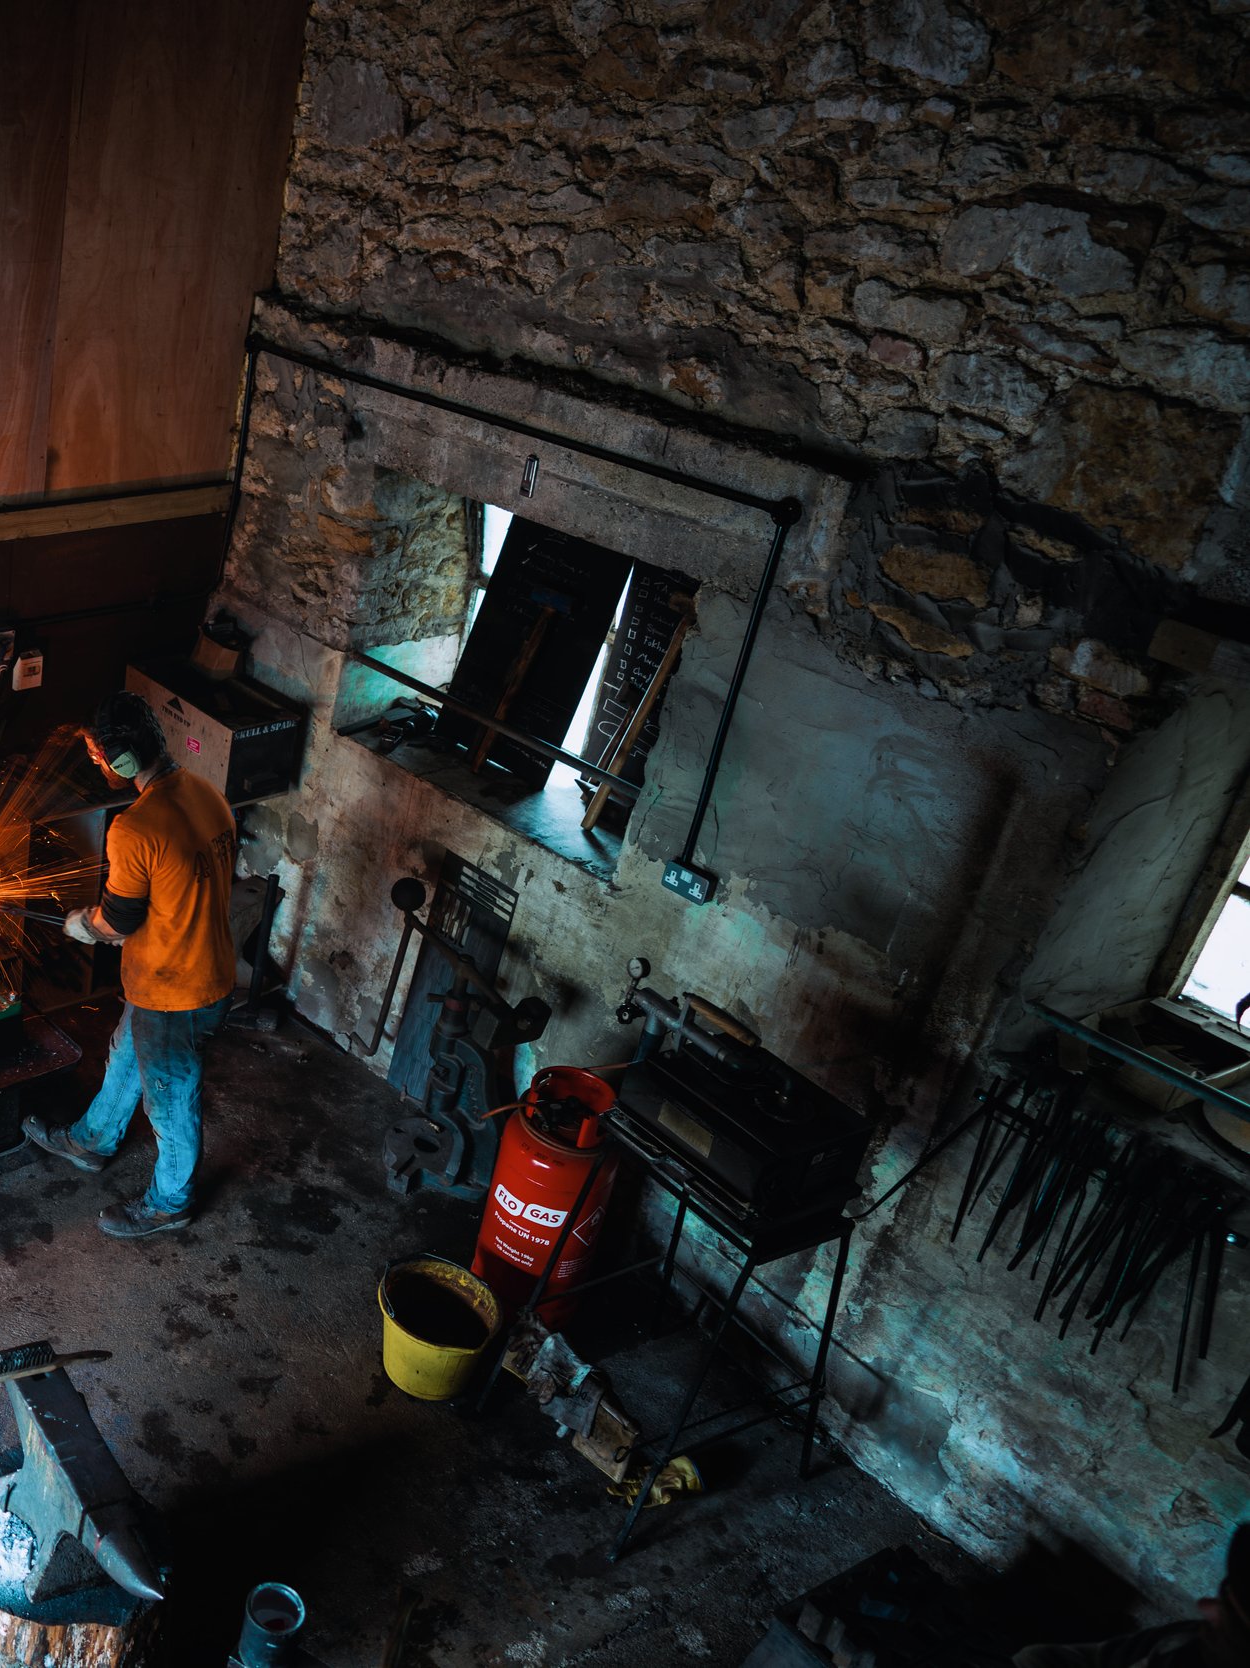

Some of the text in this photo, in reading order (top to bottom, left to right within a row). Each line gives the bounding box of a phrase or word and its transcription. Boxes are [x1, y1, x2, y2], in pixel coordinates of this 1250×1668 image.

[234, 726, 262, 741] SKULL
[262, 726, 271, 735] &
[498, 1189, 561, 1224] FLO GAS
[494, 1210, 550, 1246] Propane UN 1978
